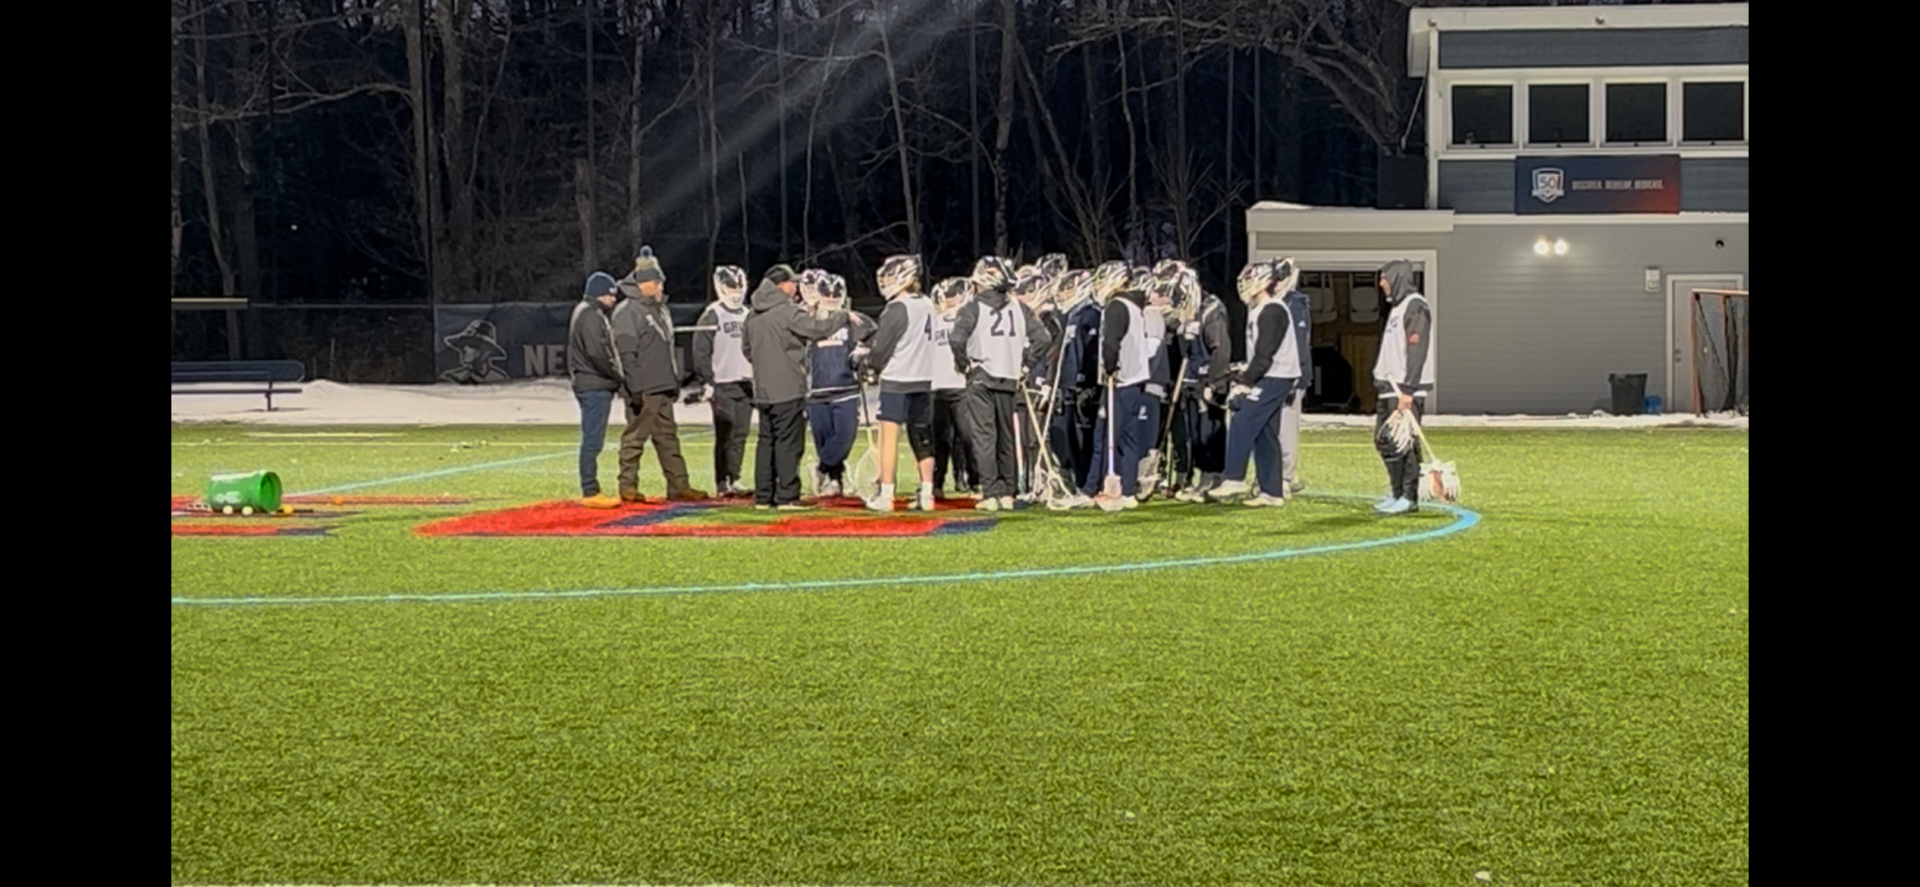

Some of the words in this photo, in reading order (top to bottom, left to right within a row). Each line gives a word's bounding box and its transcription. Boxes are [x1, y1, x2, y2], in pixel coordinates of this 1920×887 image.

[1539, 175, 1557, 189] 50
[924, 313, 932, 341] 4
[990, 309, 1016, 337] 21
